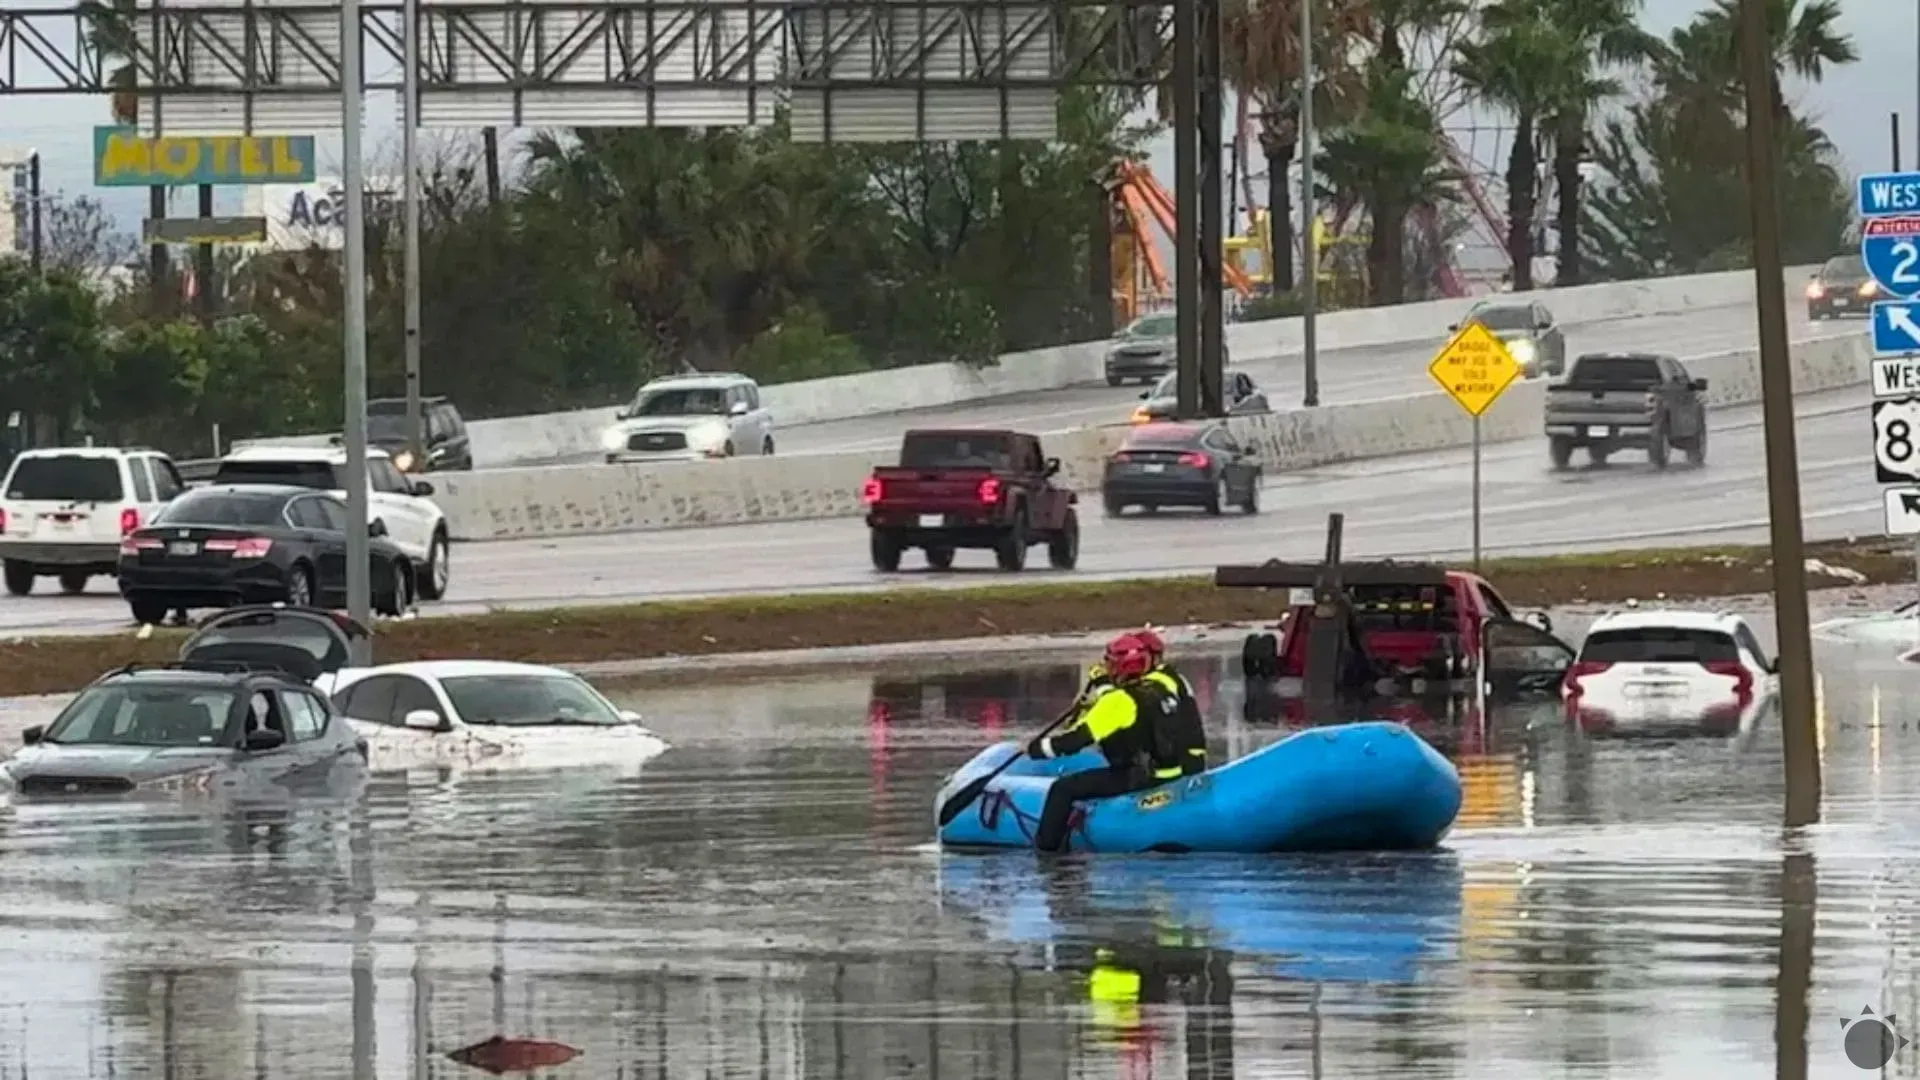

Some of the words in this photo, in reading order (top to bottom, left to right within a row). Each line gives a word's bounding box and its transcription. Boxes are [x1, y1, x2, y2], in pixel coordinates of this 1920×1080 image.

[101, 134, 303, 179] MOTEL
[1890, 242, 1919, 283] 2
[1455, 383, 1496, 393] WEATHER
[1886, 419, 1920, 462] 8
